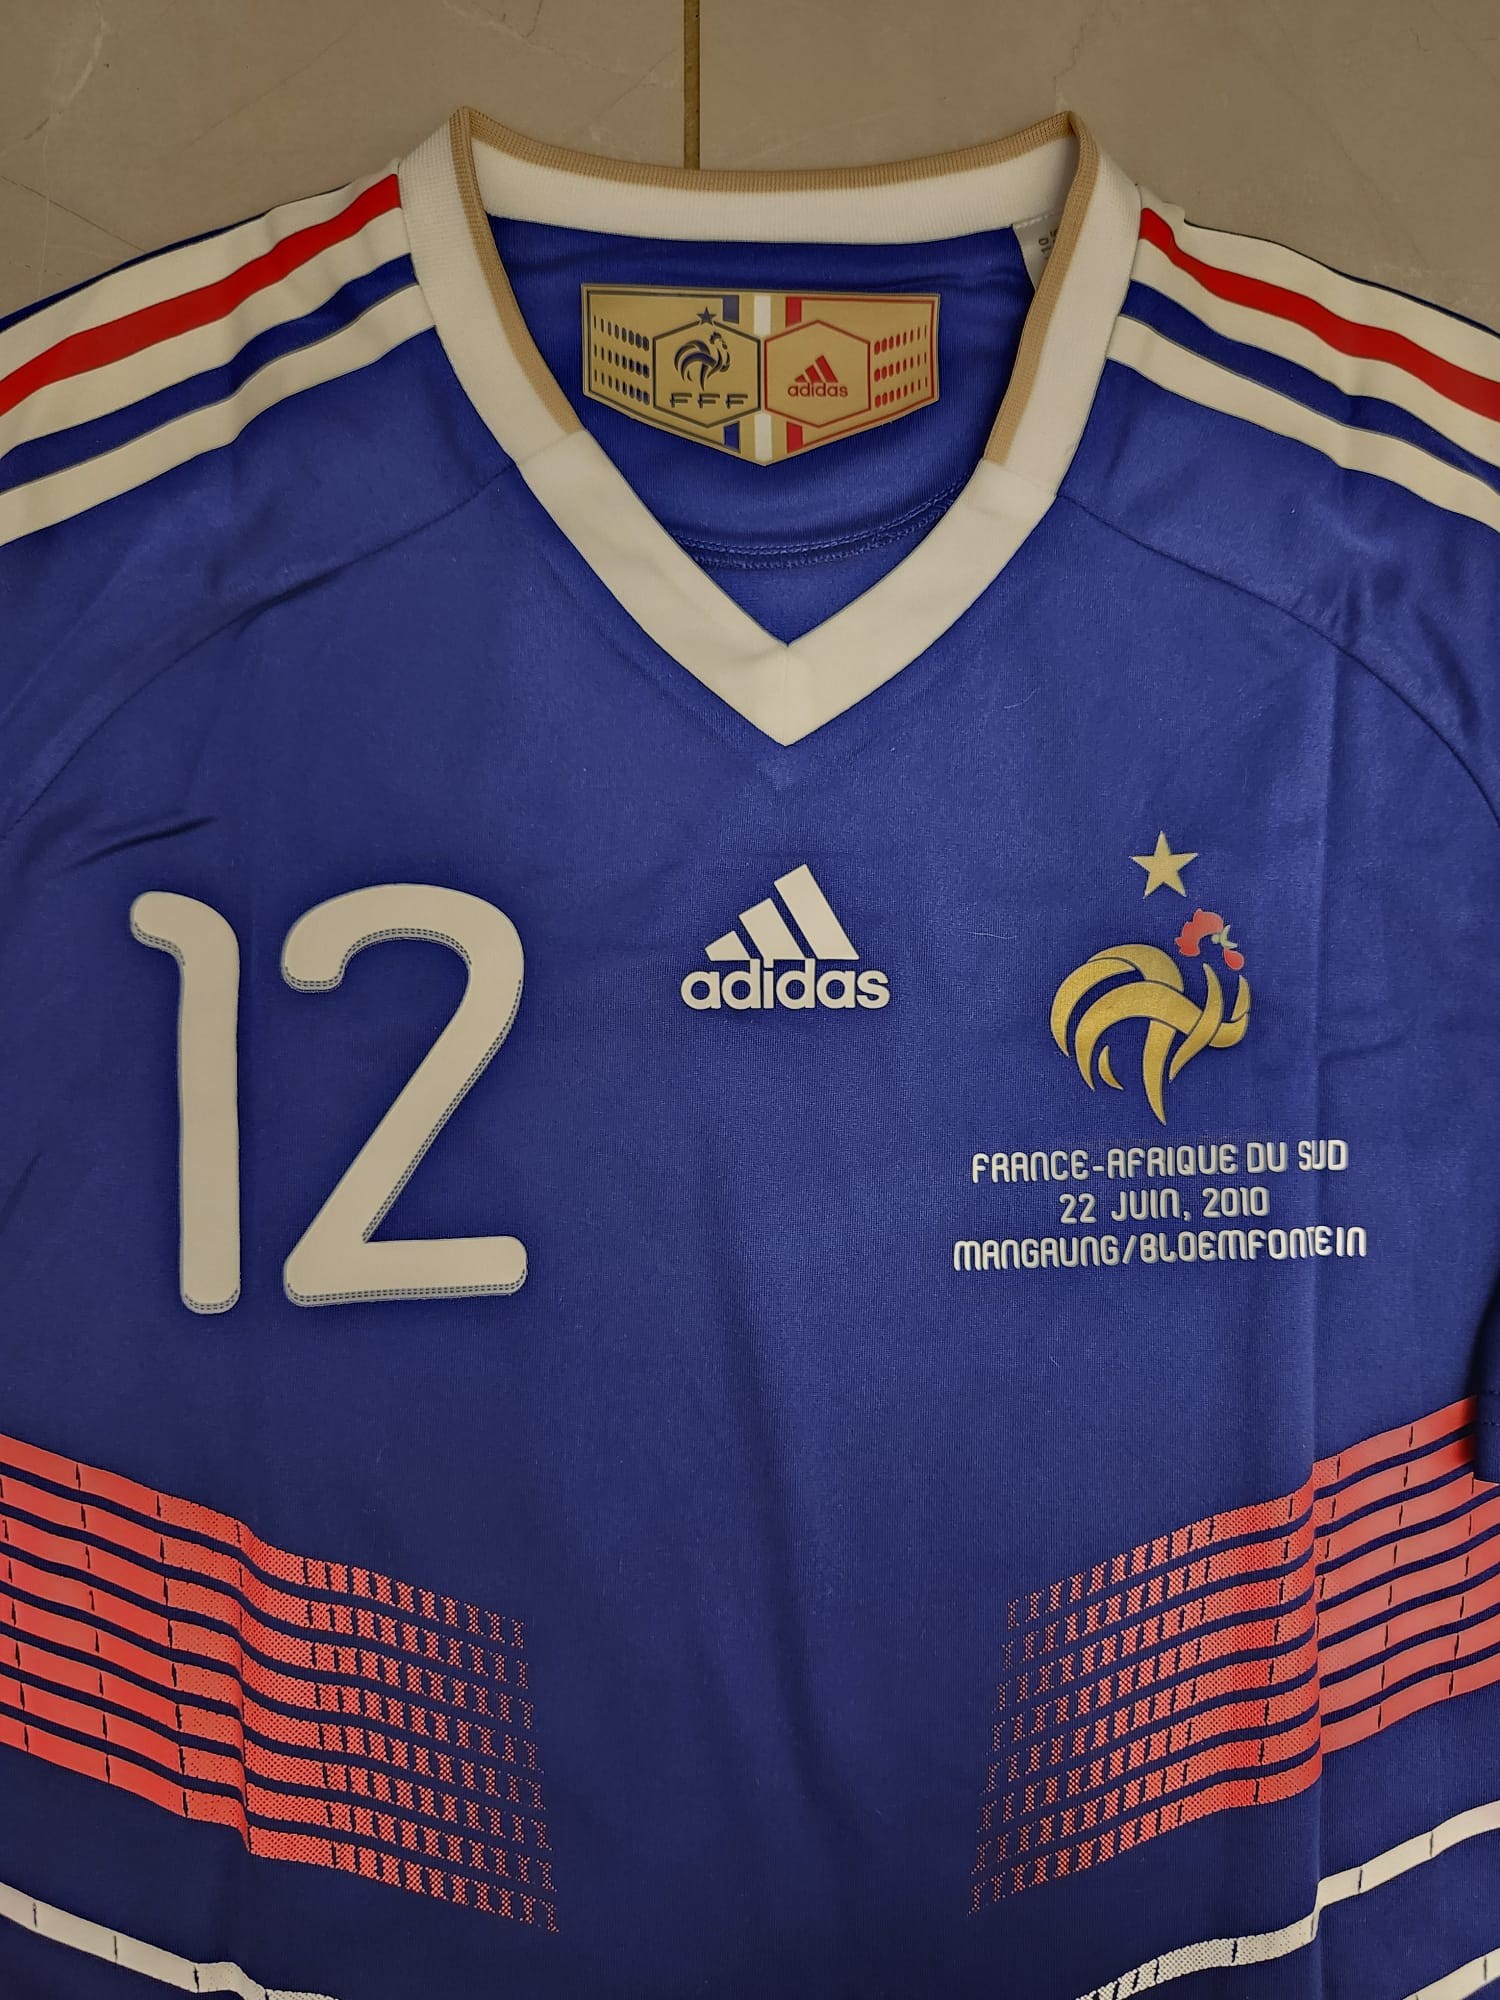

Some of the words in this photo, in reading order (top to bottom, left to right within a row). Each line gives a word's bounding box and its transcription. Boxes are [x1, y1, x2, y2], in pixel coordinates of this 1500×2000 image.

[787, 382, 849, 398] adidas
[680, 957, 890, 1010] adidas
[130, 883, 528, 1314] 12
[971, 1143, 1238, 1184] FRANCE-AFRIQUE
[1246, 1141, 1288, 1174] DU
[1297, 1139, 1349, 1172] SUD
[1059, 1193, 1097, 1224] 22
[1111, 1188, 1193, 1222] JUIN,
[1202, 1186, 1270, 1218] 2010
